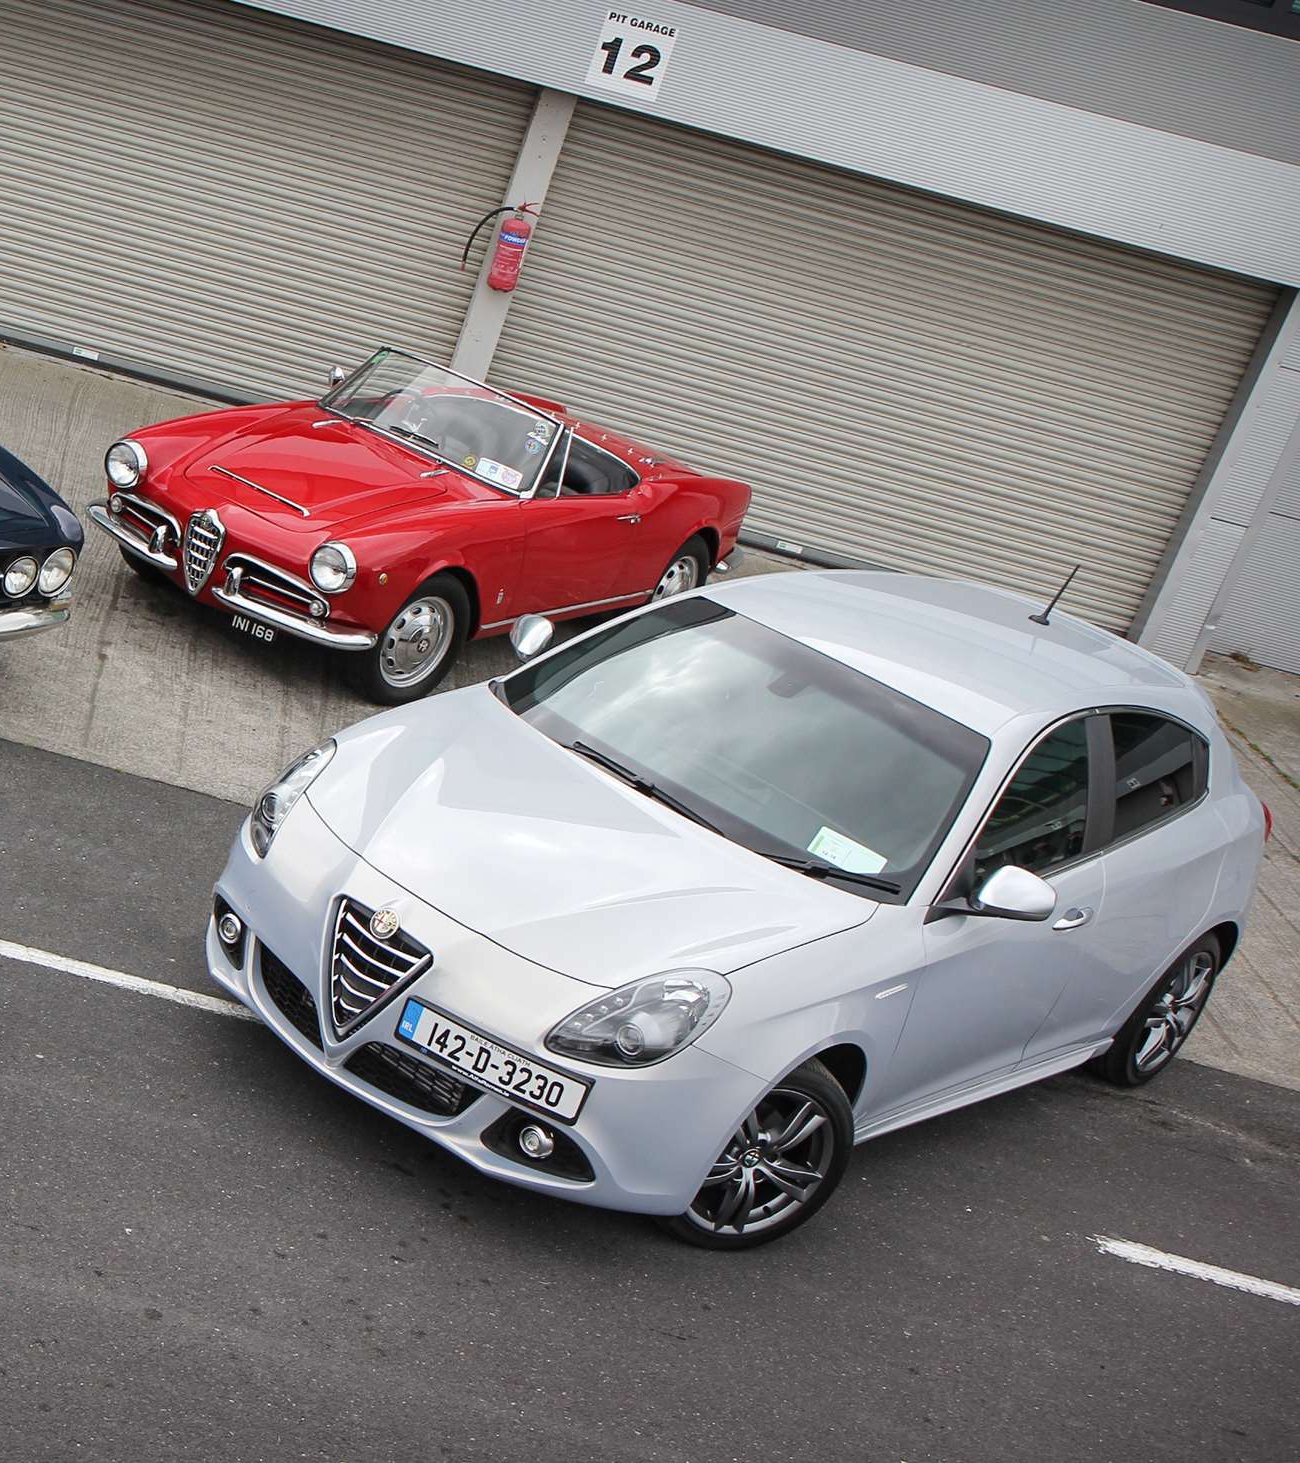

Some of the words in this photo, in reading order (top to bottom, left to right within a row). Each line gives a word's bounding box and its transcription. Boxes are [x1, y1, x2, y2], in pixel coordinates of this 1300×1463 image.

[608, 11, 628, 24] PIT
[630, 18, 676, 37] GARAGE
[600, 37, 661, 86] 12
[251, 623, 275, 642] 168
[401, 1020, 413, 1033] IRL
[427, 1022, 565, 1108] 142-D-3230
